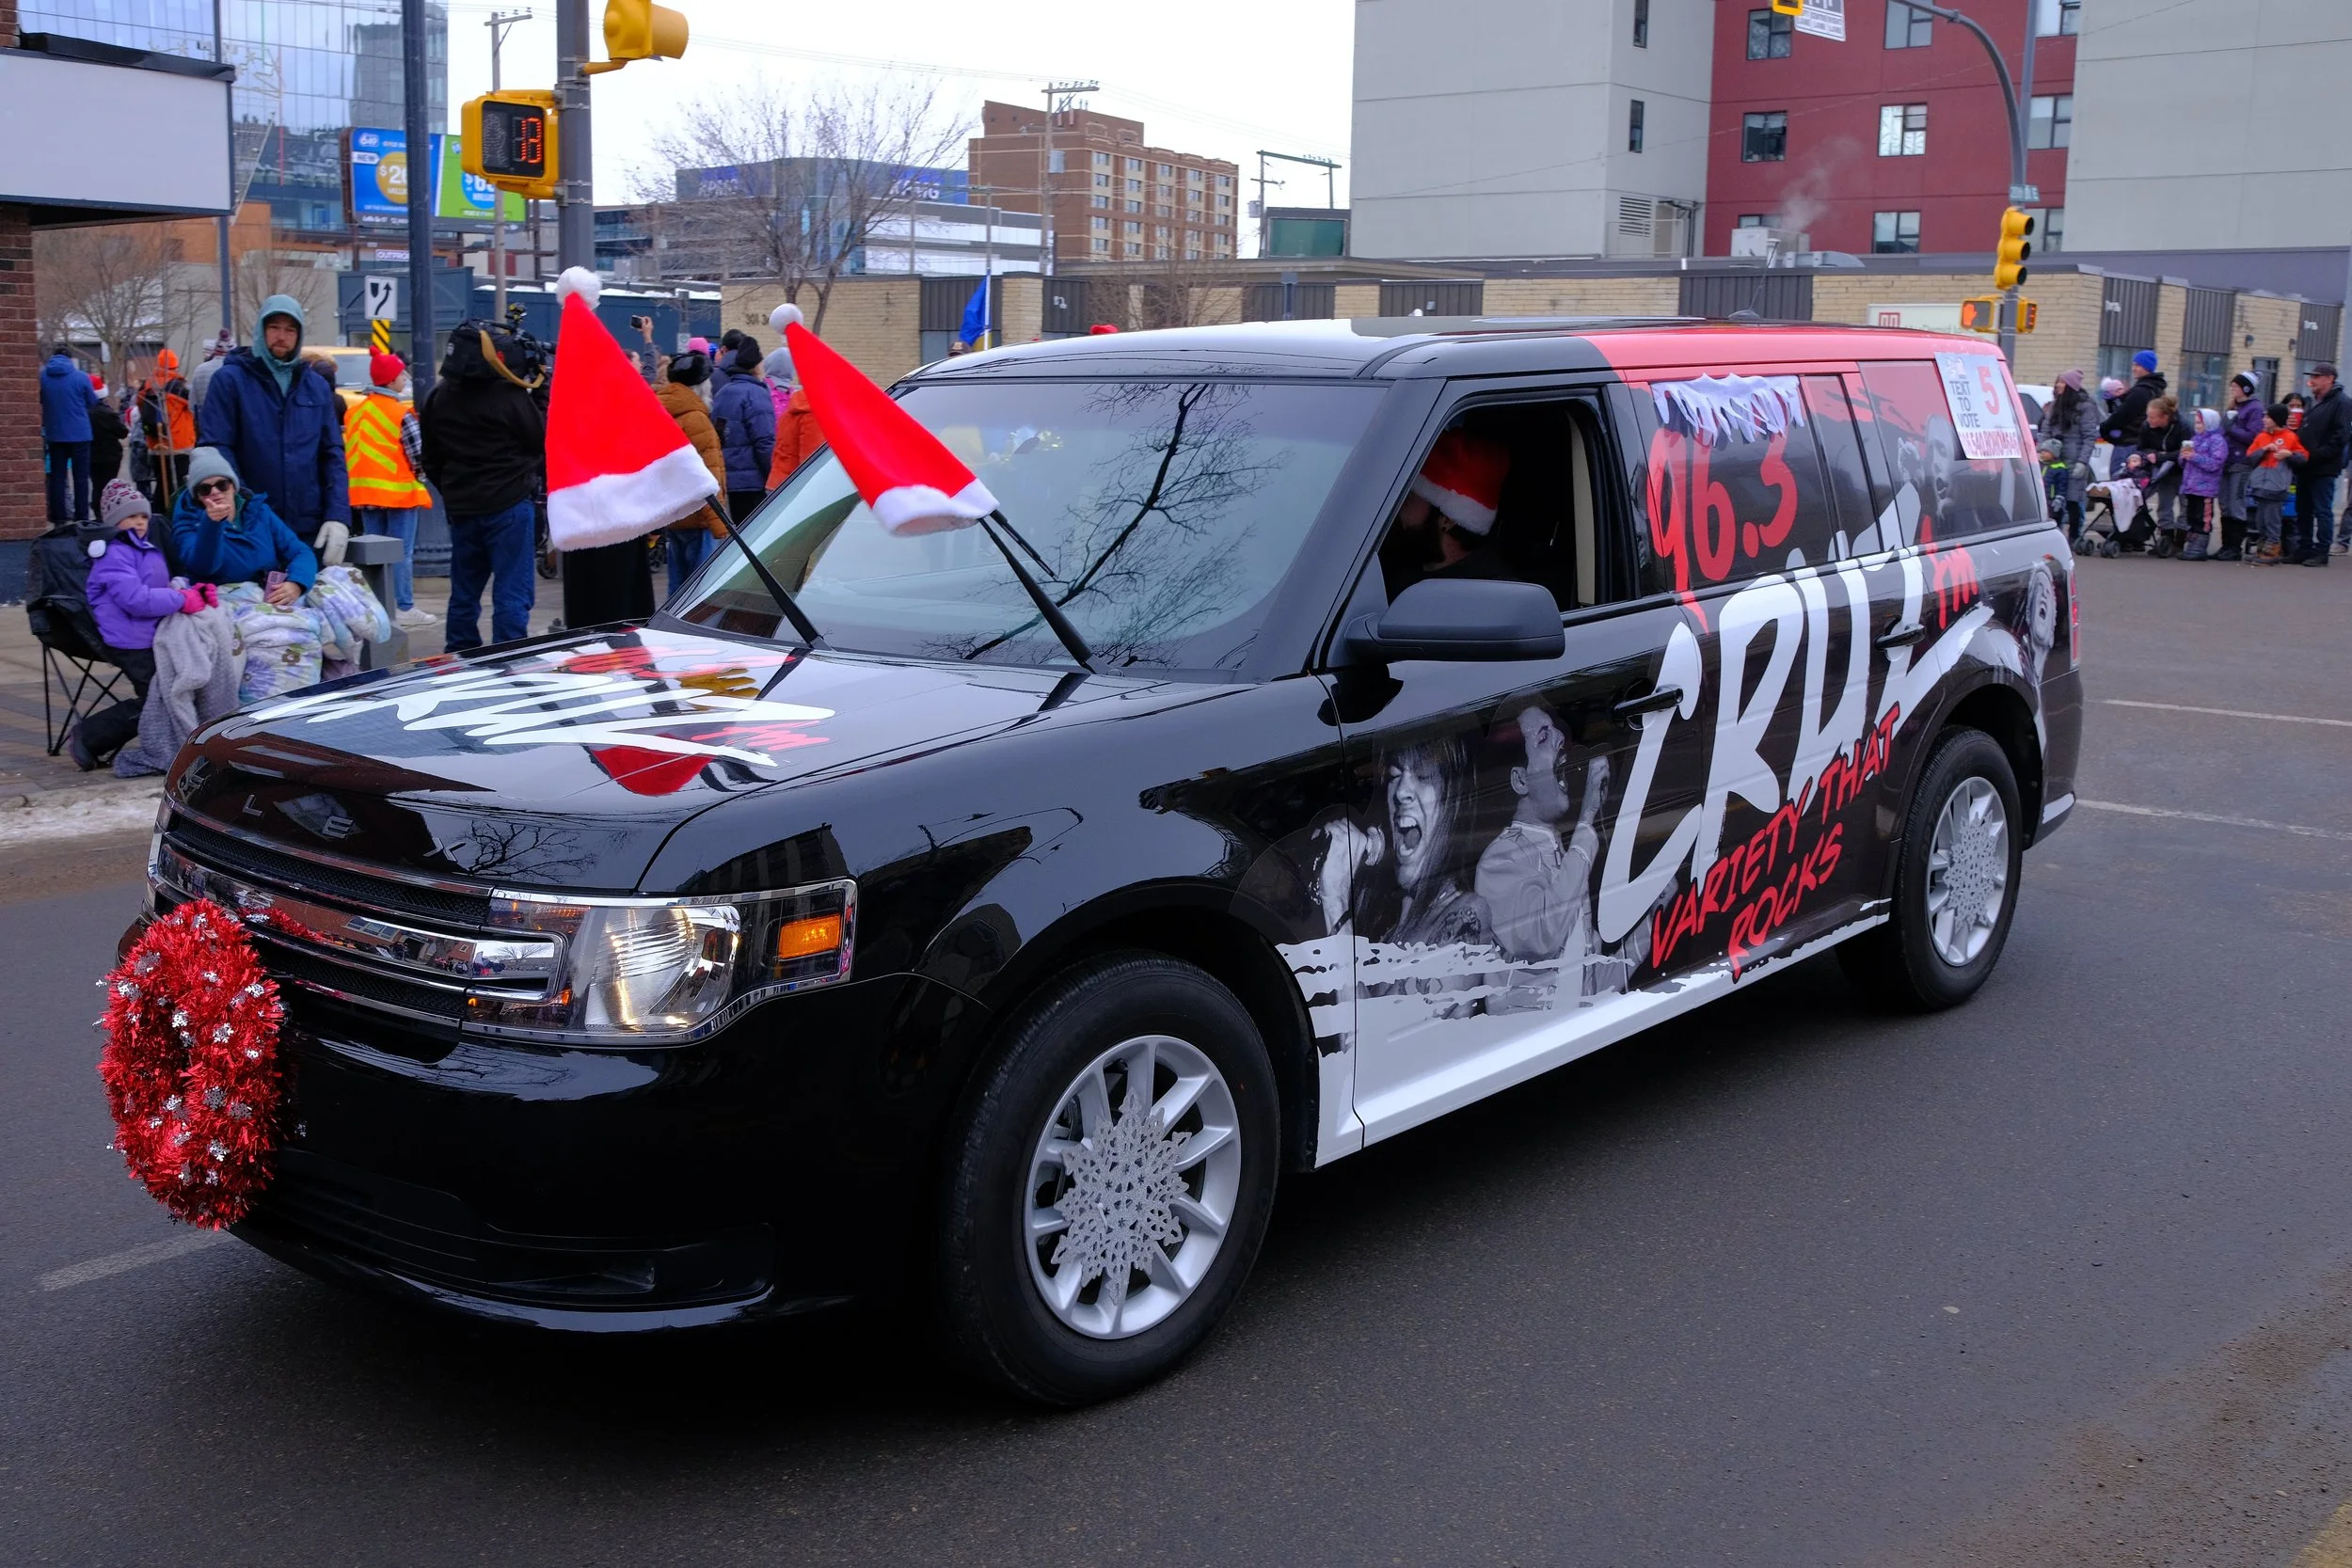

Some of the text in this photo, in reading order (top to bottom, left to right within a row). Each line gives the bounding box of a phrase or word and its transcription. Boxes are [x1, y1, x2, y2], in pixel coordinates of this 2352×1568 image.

[521, 118, 542, 164] 13
[888, 179, 941, 199] KPMG
[1949, 381, 1971, 396] TEXT
[1957, 397, 1972, 412] TO
[1978, 366, 2000, 416] 5
[1957, 413, 1981, 429] VOTE
[1646, 393, 1798, 635] 96.3
[1598, 482, 1994, 942] CRUZ
[1650, 701, 1900, 969] VARIETY THAT
[1726, 822, 1842, 984] ROCKS
